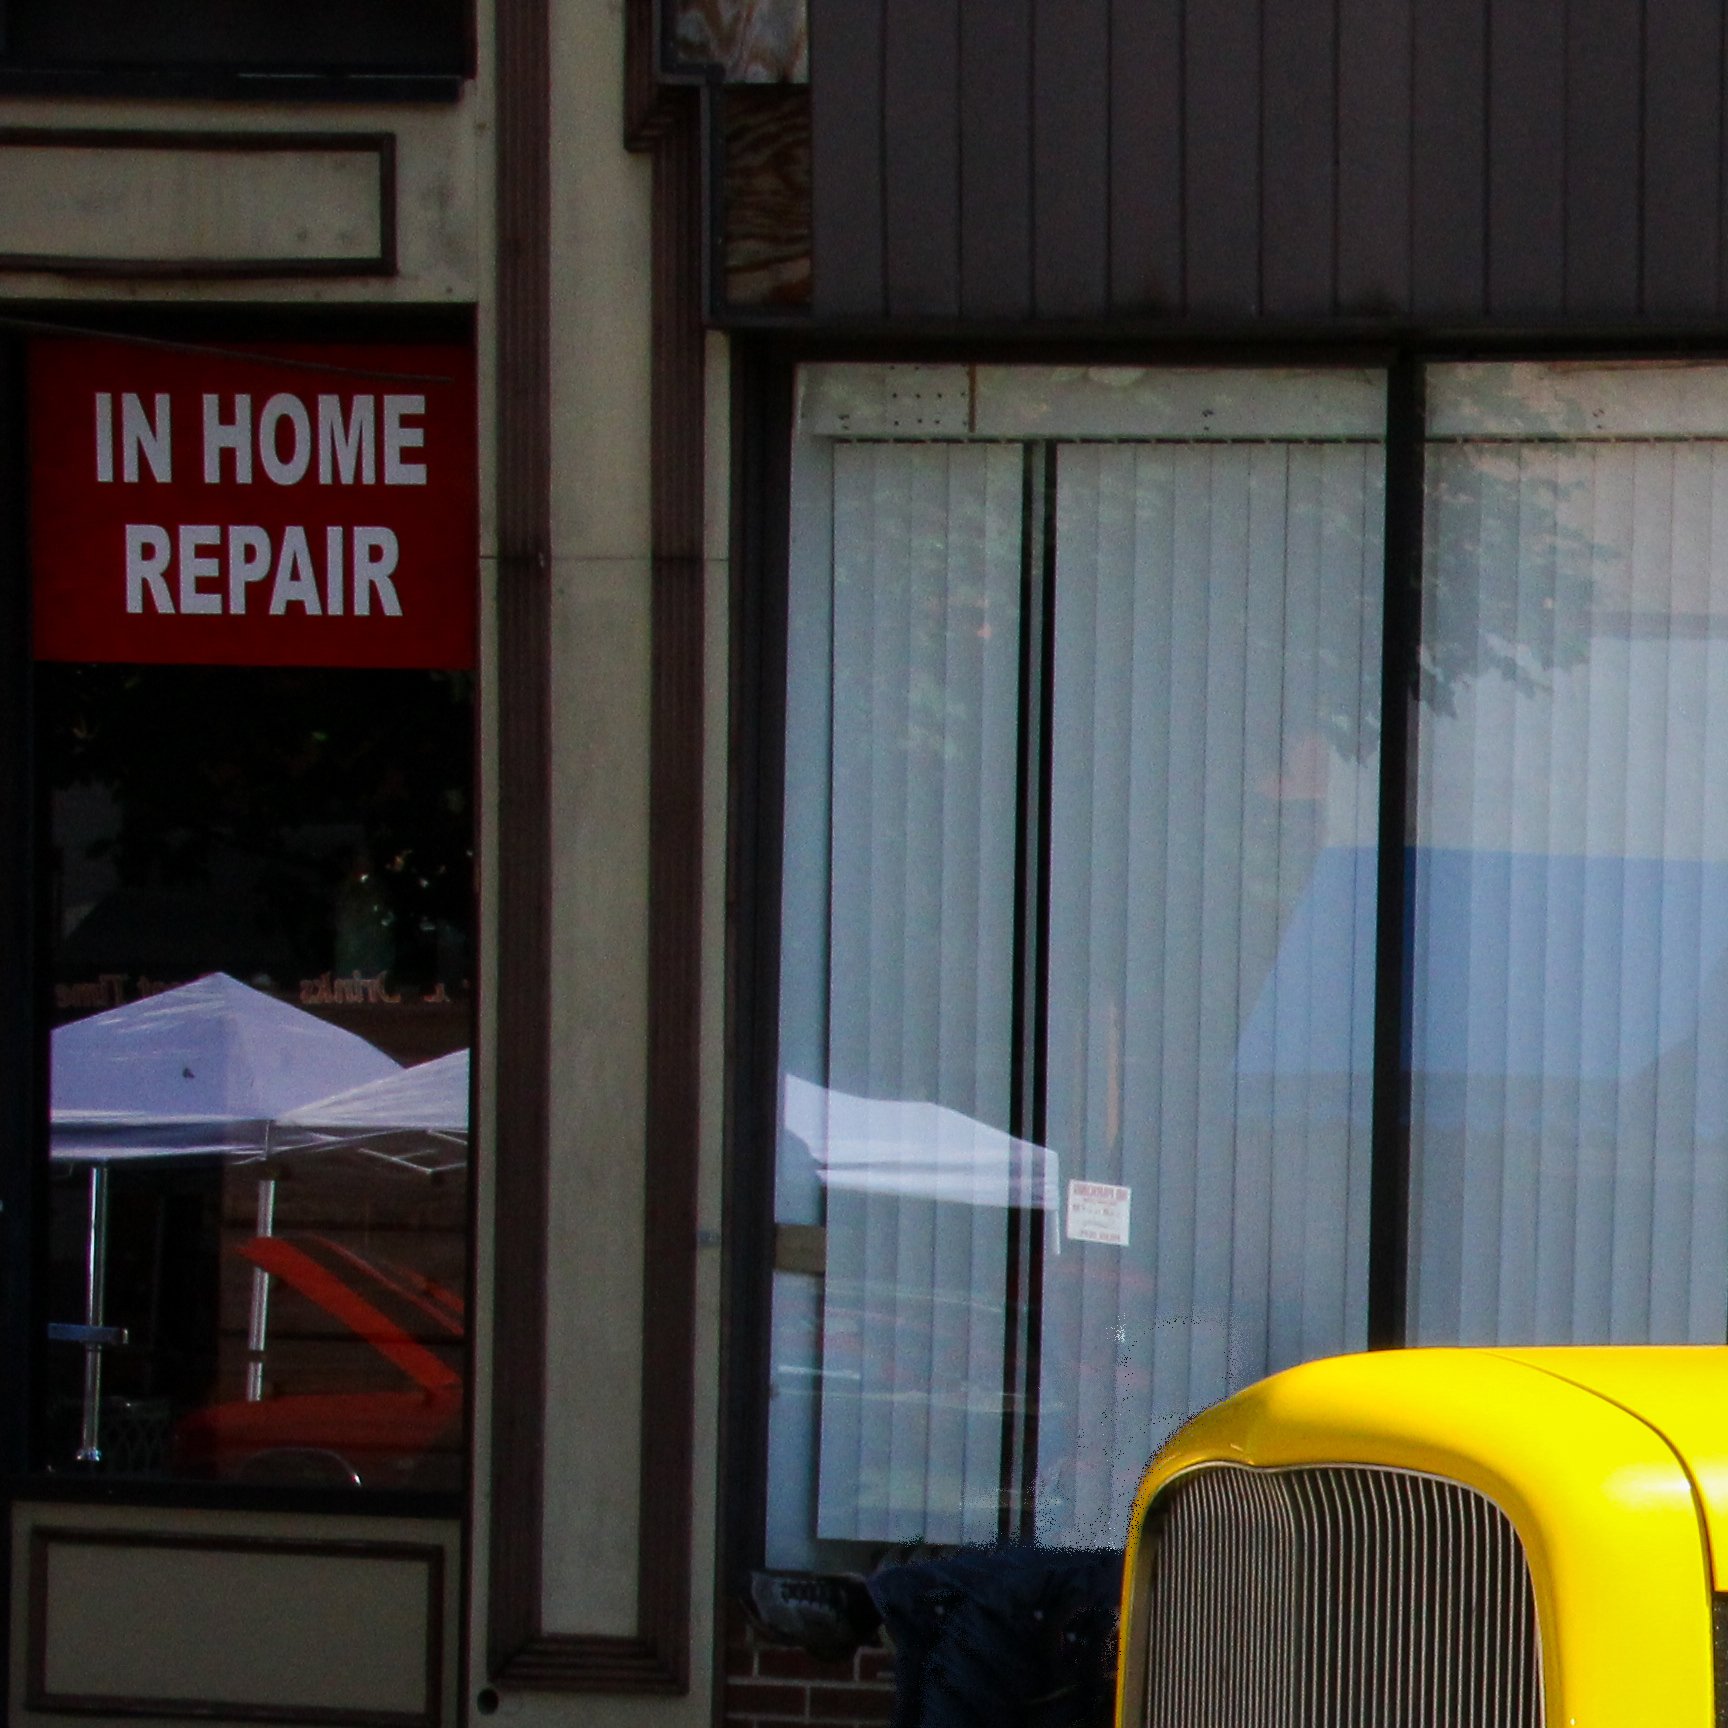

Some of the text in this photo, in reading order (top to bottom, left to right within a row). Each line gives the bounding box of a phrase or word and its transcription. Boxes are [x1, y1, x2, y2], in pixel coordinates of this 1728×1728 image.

[95, 392, 428, 486] IN HOME
[124, 524, 403, 617] REPAIR
